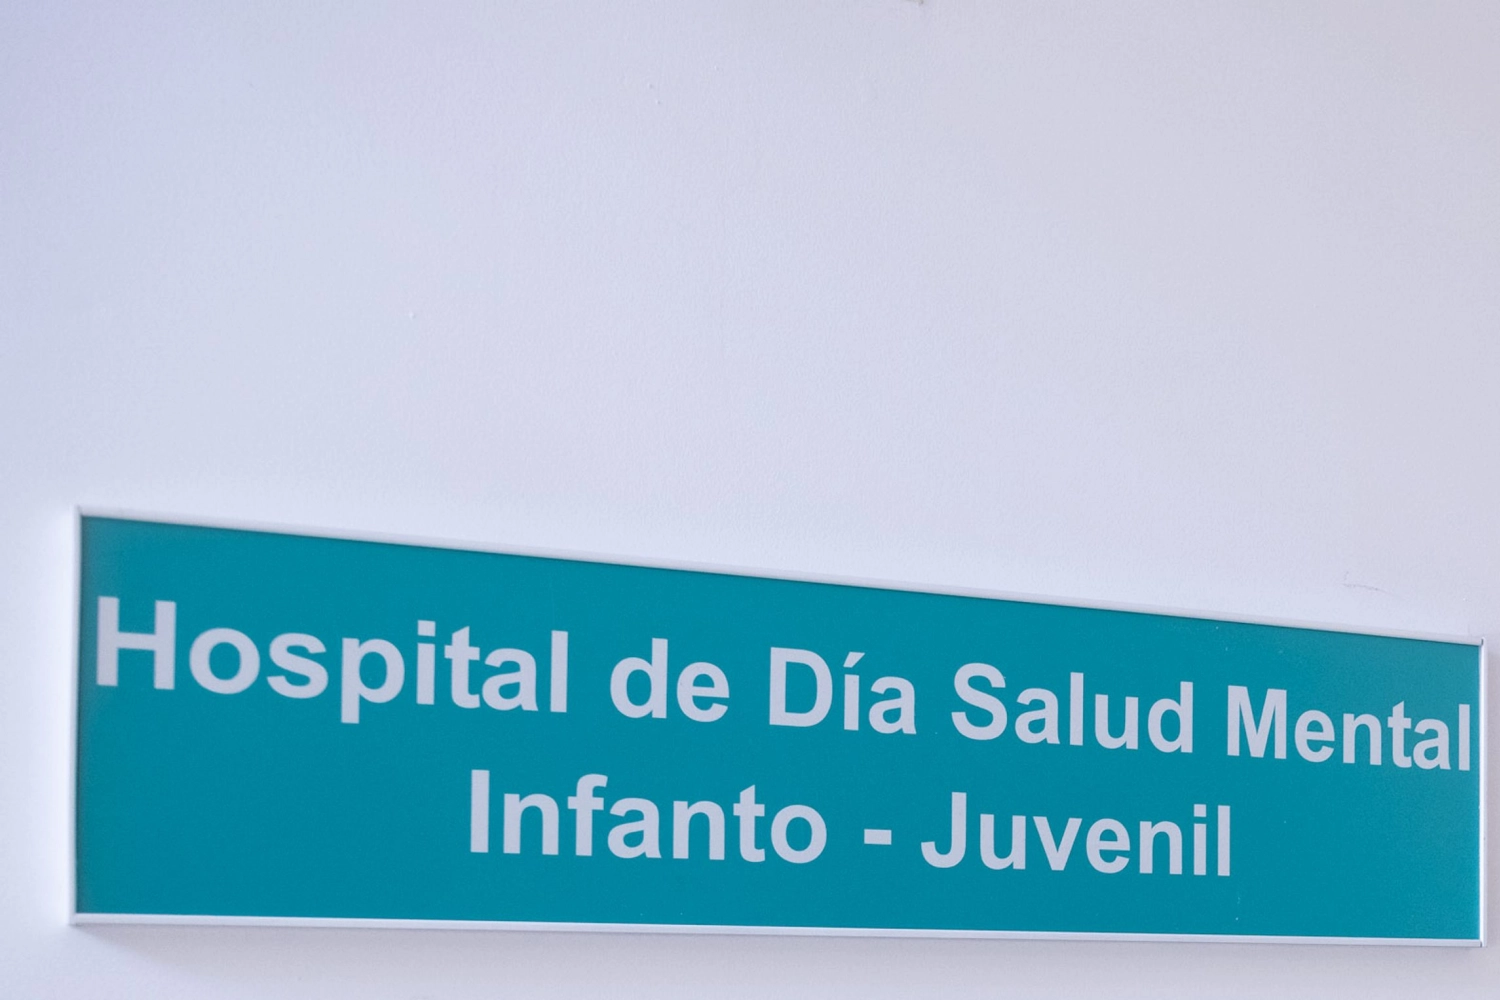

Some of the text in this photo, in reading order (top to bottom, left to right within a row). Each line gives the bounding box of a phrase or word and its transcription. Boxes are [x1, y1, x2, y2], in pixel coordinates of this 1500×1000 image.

[97, 596, 1471, 771] Hospital de Día Salud Mental
[470, 769, 1231, 876] Infanto - Juvenil
